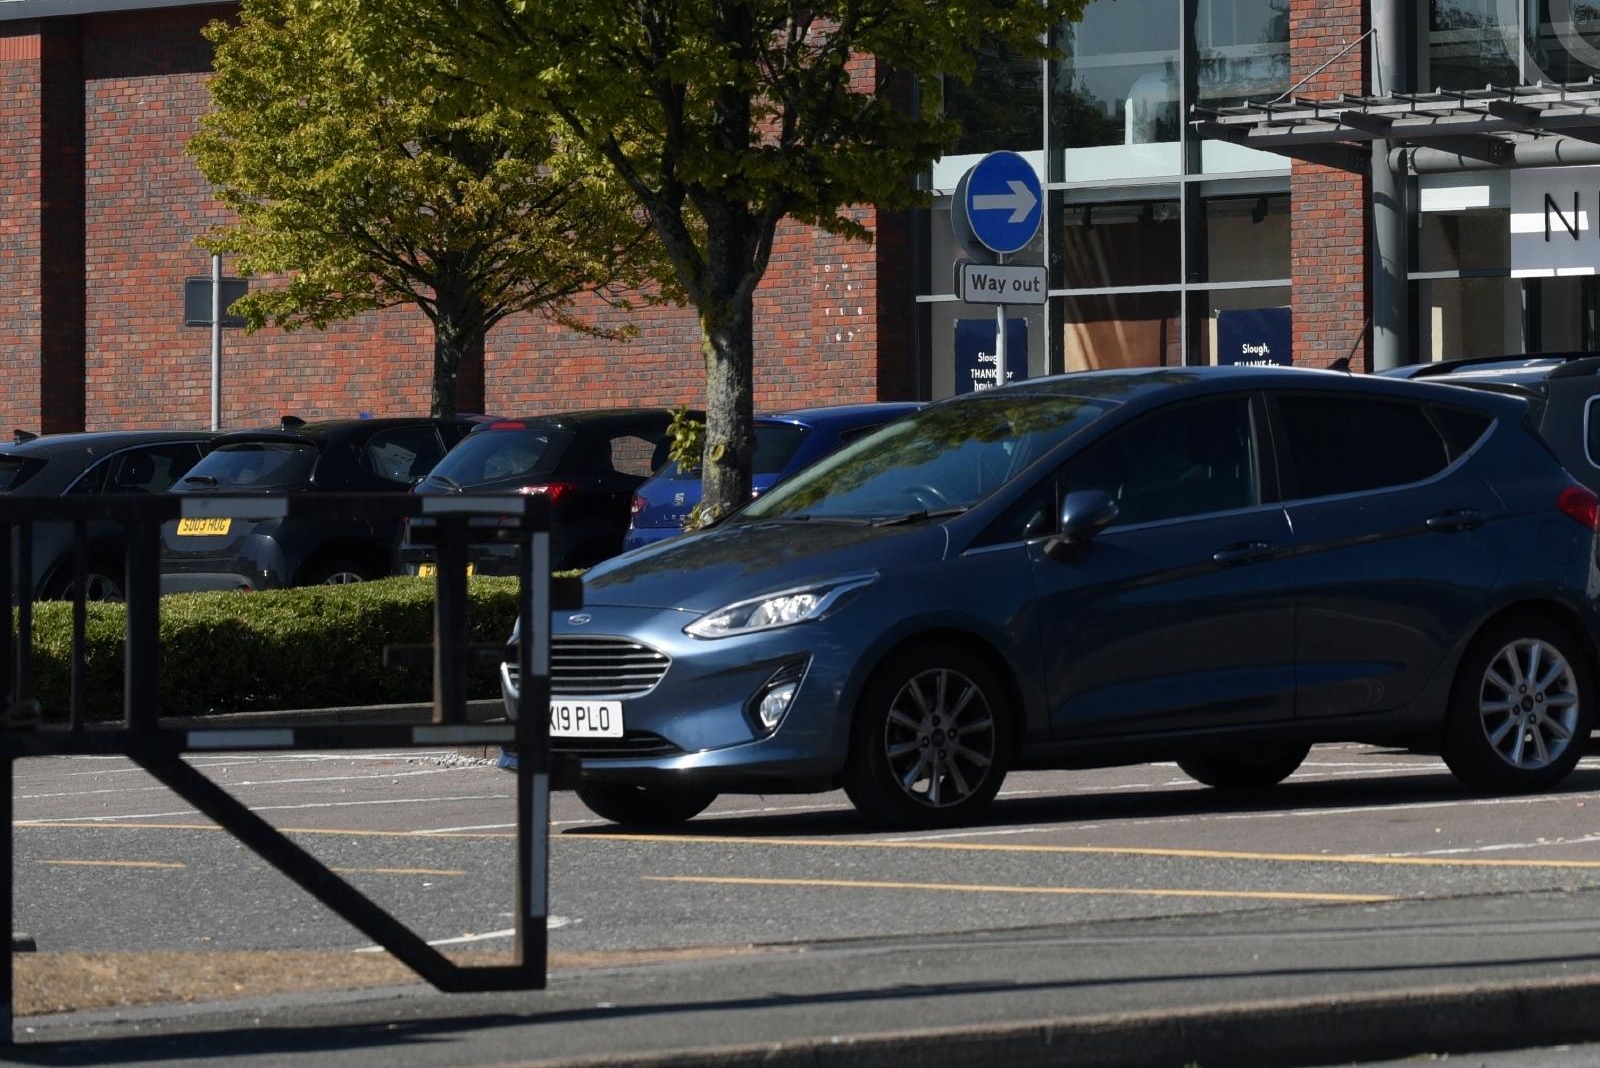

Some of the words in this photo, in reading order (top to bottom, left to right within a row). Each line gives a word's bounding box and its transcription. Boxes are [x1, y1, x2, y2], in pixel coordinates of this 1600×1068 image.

[971, 274, 1006, 293] Way
[1013, 277, 1040, 292] out
[1242, 342, 1270, 356] Slough,
[978, 352, 997, 365] Sloug
[971, 368, 997, 379] THANK
[576, 706, 609, 731] PLO
